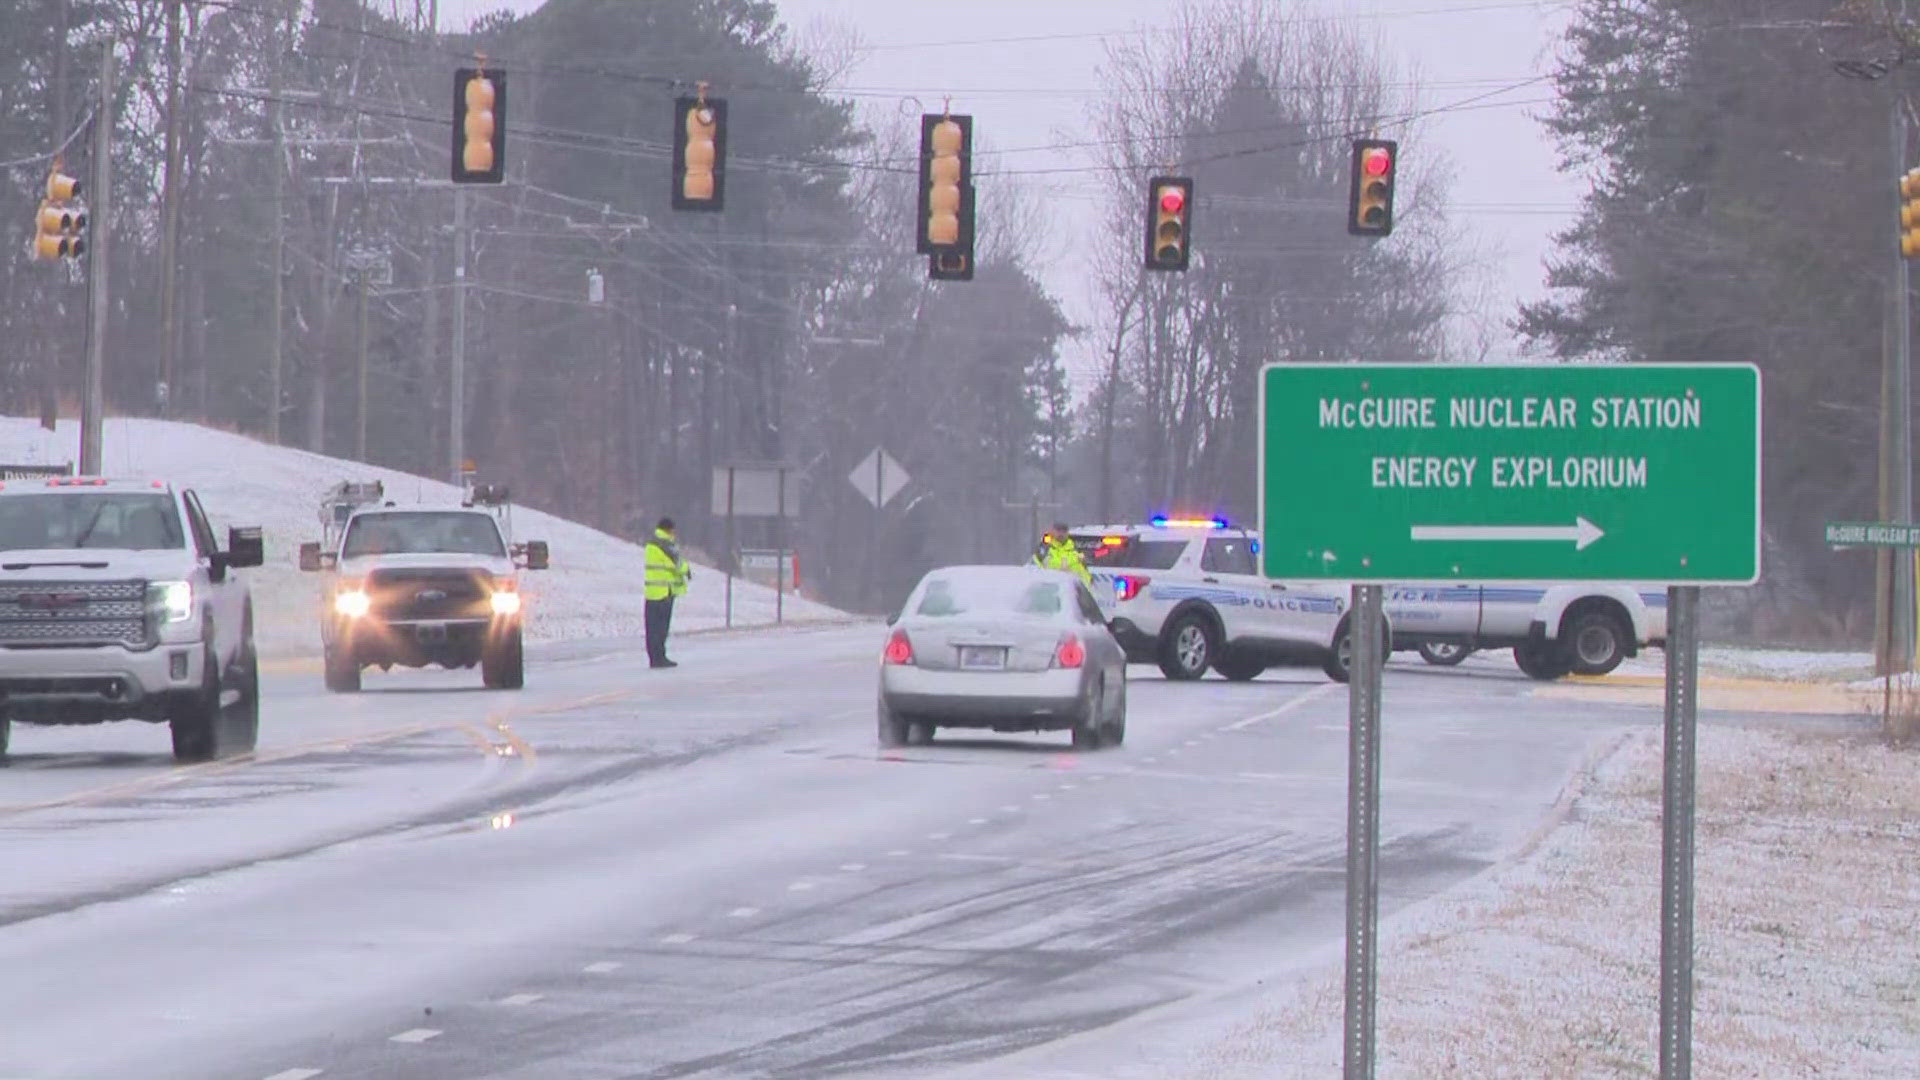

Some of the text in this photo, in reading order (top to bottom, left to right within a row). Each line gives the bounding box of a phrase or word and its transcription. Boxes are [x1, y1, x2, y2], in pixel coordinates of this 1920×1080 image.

[1318, 397, 1702, 429] McGUIRE NUCLEAR STATION
[1371, 456, 1648, 488] ENERGY EXPLORIUM
[1867, 526, 1908, 544] NUCLEAR
[1241, 597, 1311, 612] POLICE
